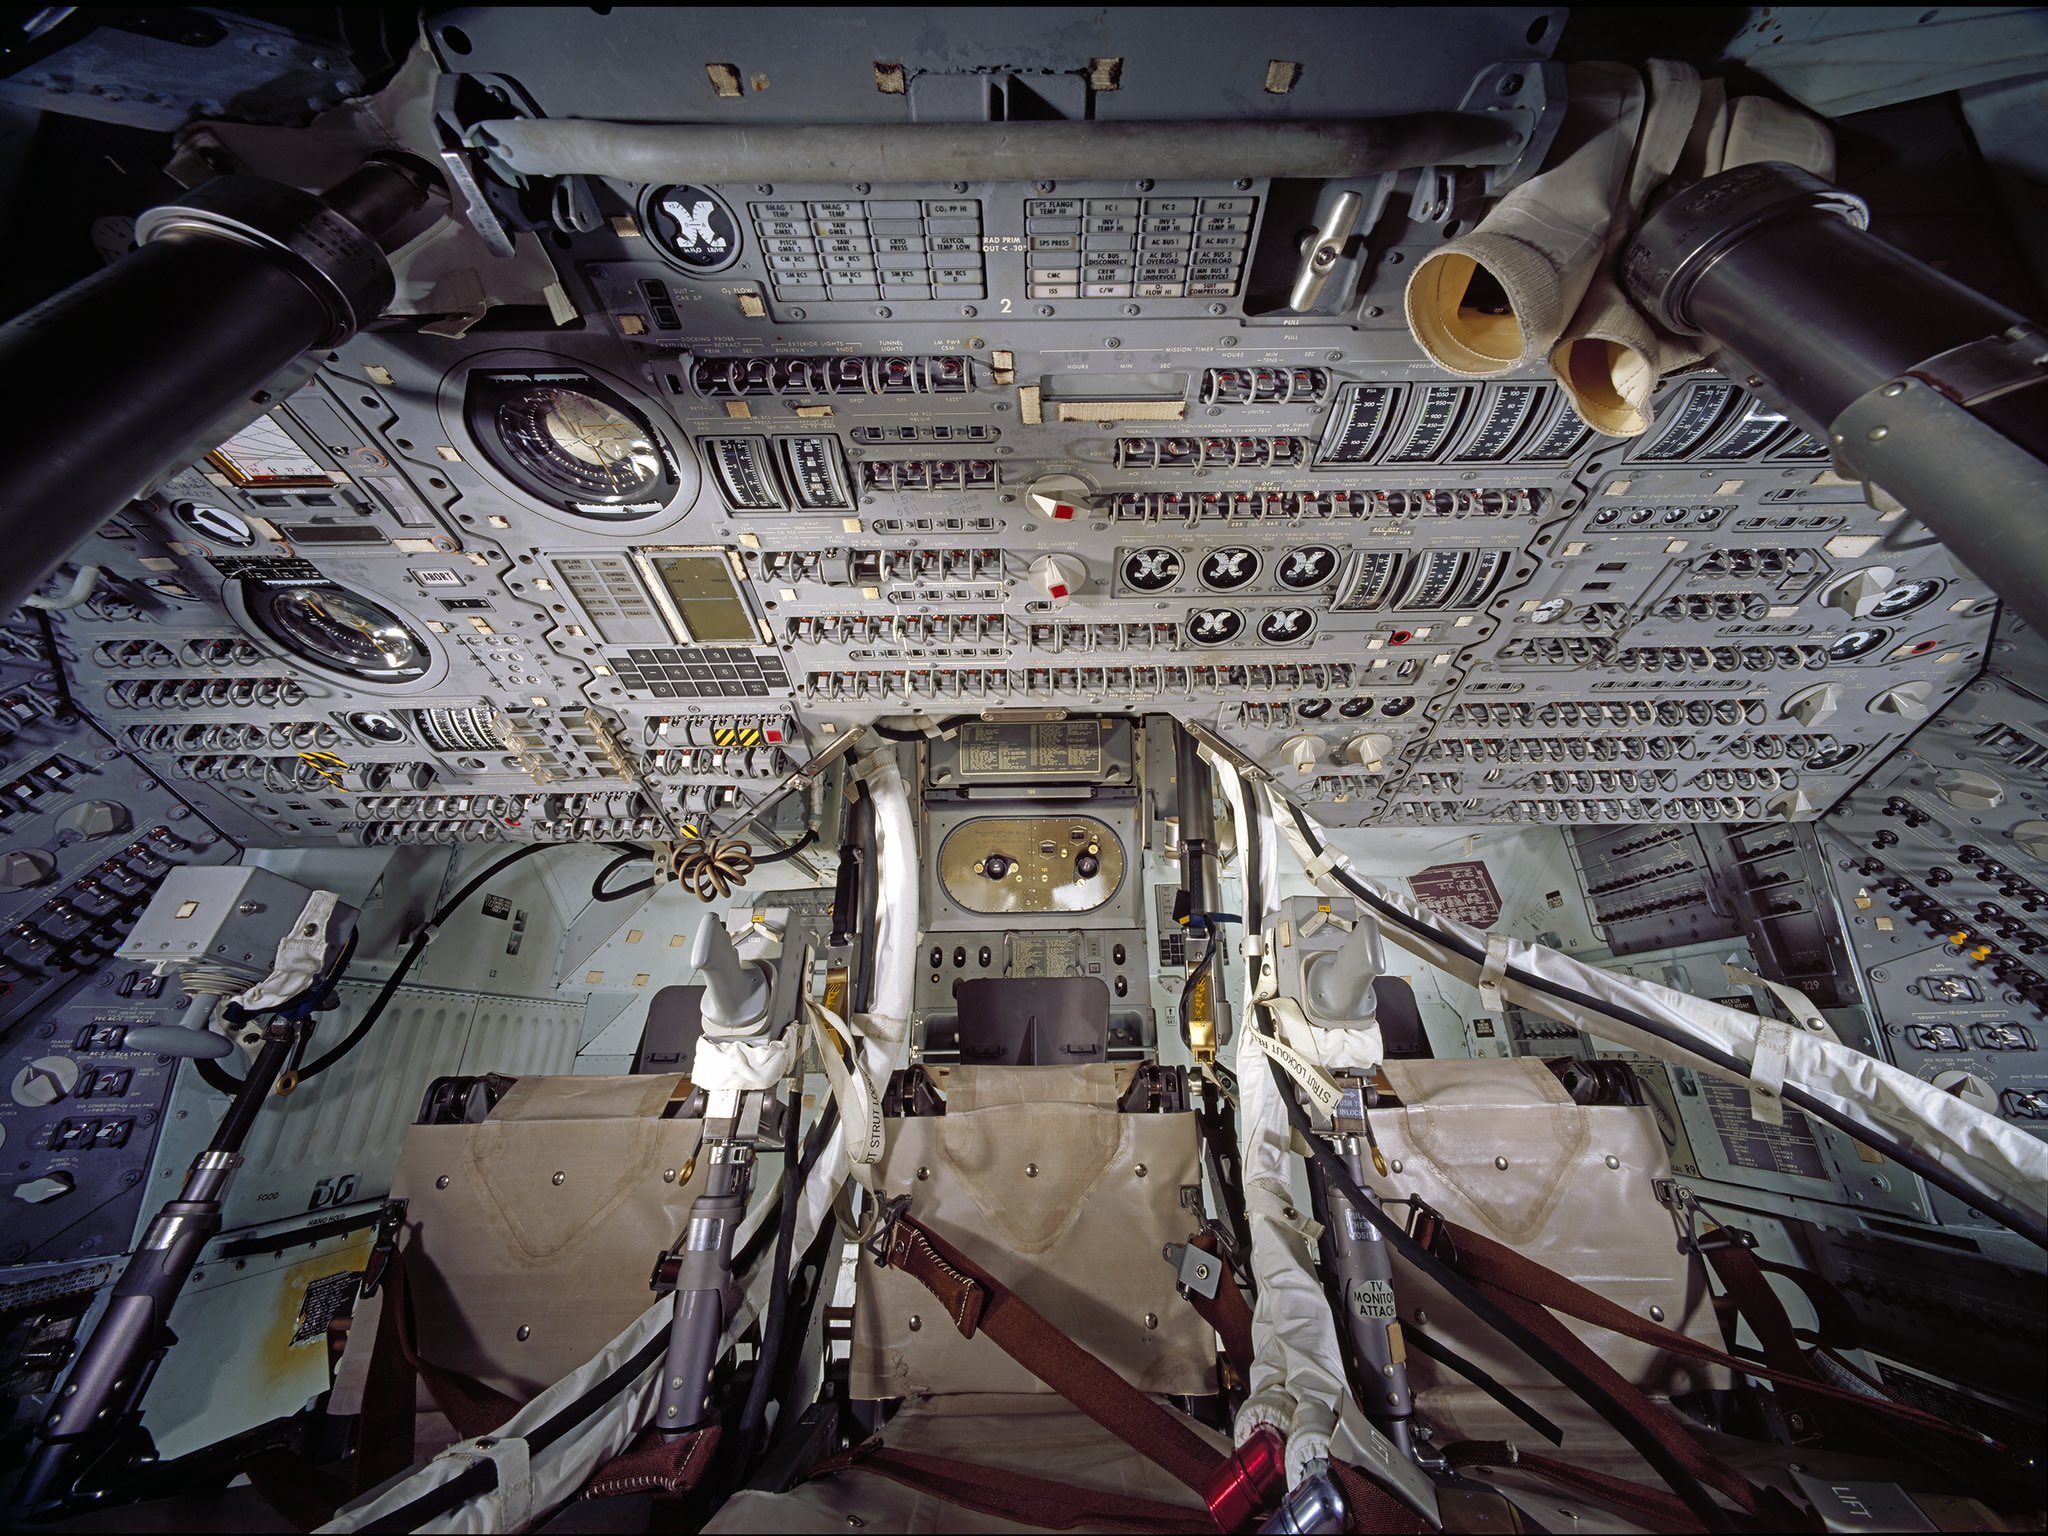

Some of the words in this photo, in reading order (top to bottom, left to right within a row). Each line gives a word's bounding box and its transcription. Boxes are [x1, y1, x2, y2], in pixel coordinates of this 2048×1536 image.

[1000, 299, 1012, 314] 2
[423, 572, 453, 582] ABORT
[1858, 887, 1868, 897] 4
[1569, 938, 1578, 947] R5
[489, 969, 497, 978] L2
[1802, 980, 1819, 991] 229
[1272, 1044, 1306, 1078] LOCKOUT
[1306, 1074, 1331, 1104] STRUT
[870, 1109, 880, 1148] STRUT
[1684, 1164, 1696, 1175] R9
[257, 1192, 279, 1202] FOOD
[308, 1217, 328, 1226] HAND
[328, 1213, 346, 1224] HOLD
[1370, 1281, 1383, 1292] TV
[1354, 1291, 1394, 1304] MONITO
[1371, 1430, 1389, 1464] LIFT
[1831, 1486, 1872, 1518] LIFT
